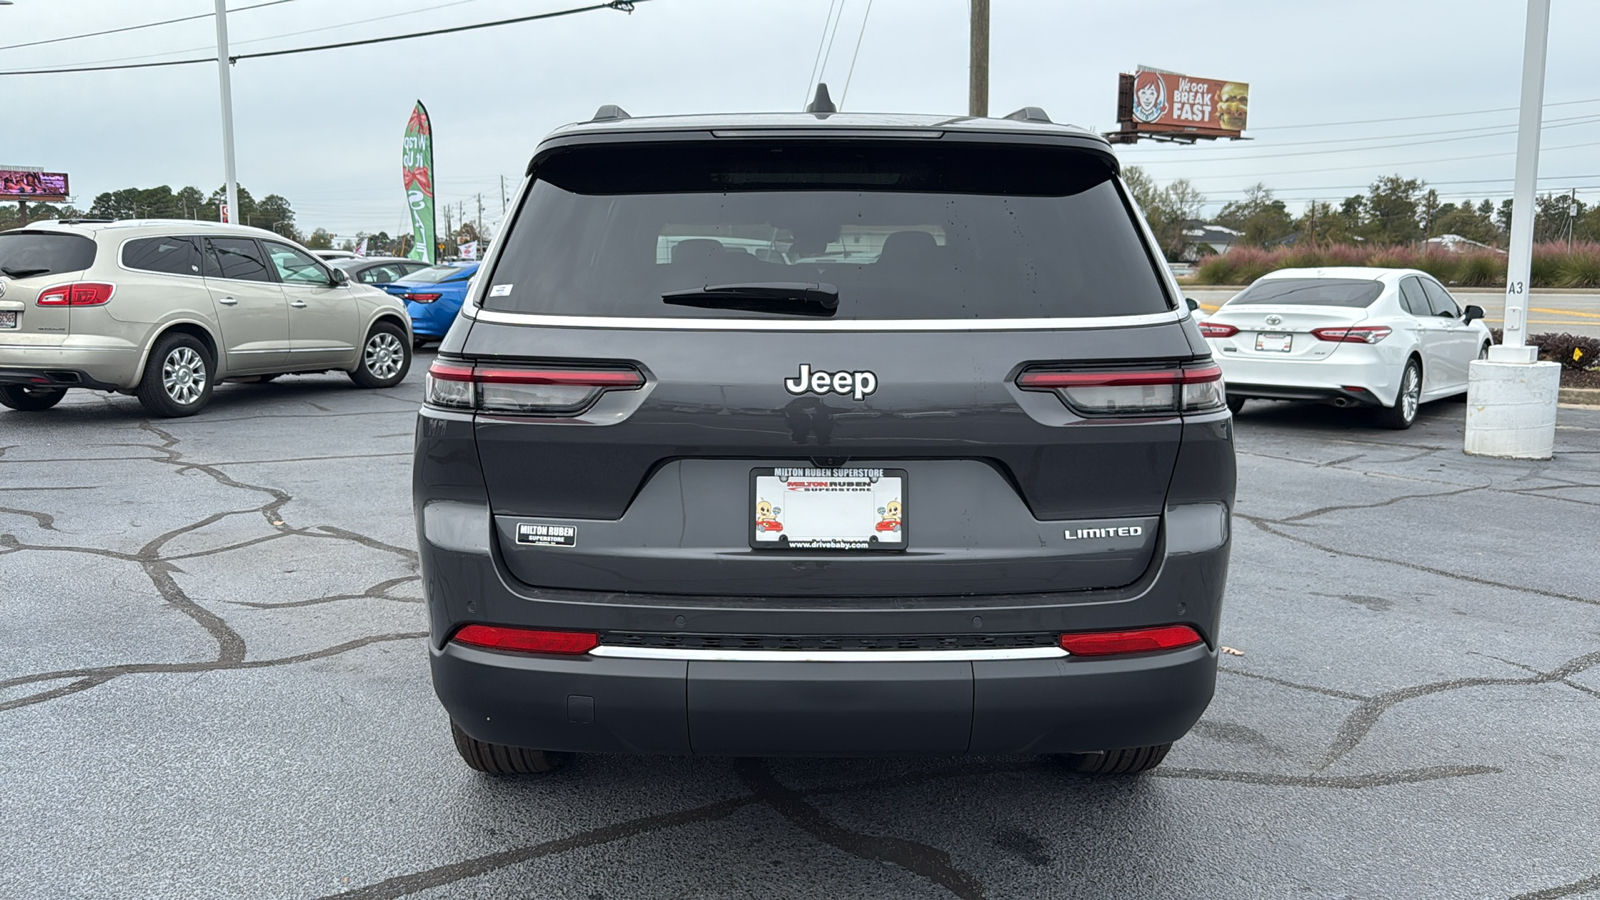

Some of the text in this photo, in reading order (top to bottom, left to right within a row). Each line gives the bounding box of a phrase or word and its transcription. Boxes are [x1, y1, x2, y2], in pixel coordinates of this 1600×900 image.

[1179, 77, 1208, 93] We GOT
[1173, 90, 1212, 105] BREAK
[1172, 102, 1212, 122] FAST
[1508, 281, 1523, 294] A3
[785, 364, 877, 400] Jeep
[774, 467, 884, 478] MILTON RUBEN SUPERSTORE
[520, 525, 574, 537] MILTON RUBEN
[1064, 526, 1142, 540] LIMITED
[528, 535, 565, 543] SUPERSTORE
[788, 541, 869, 550] www.drivebaby.com
